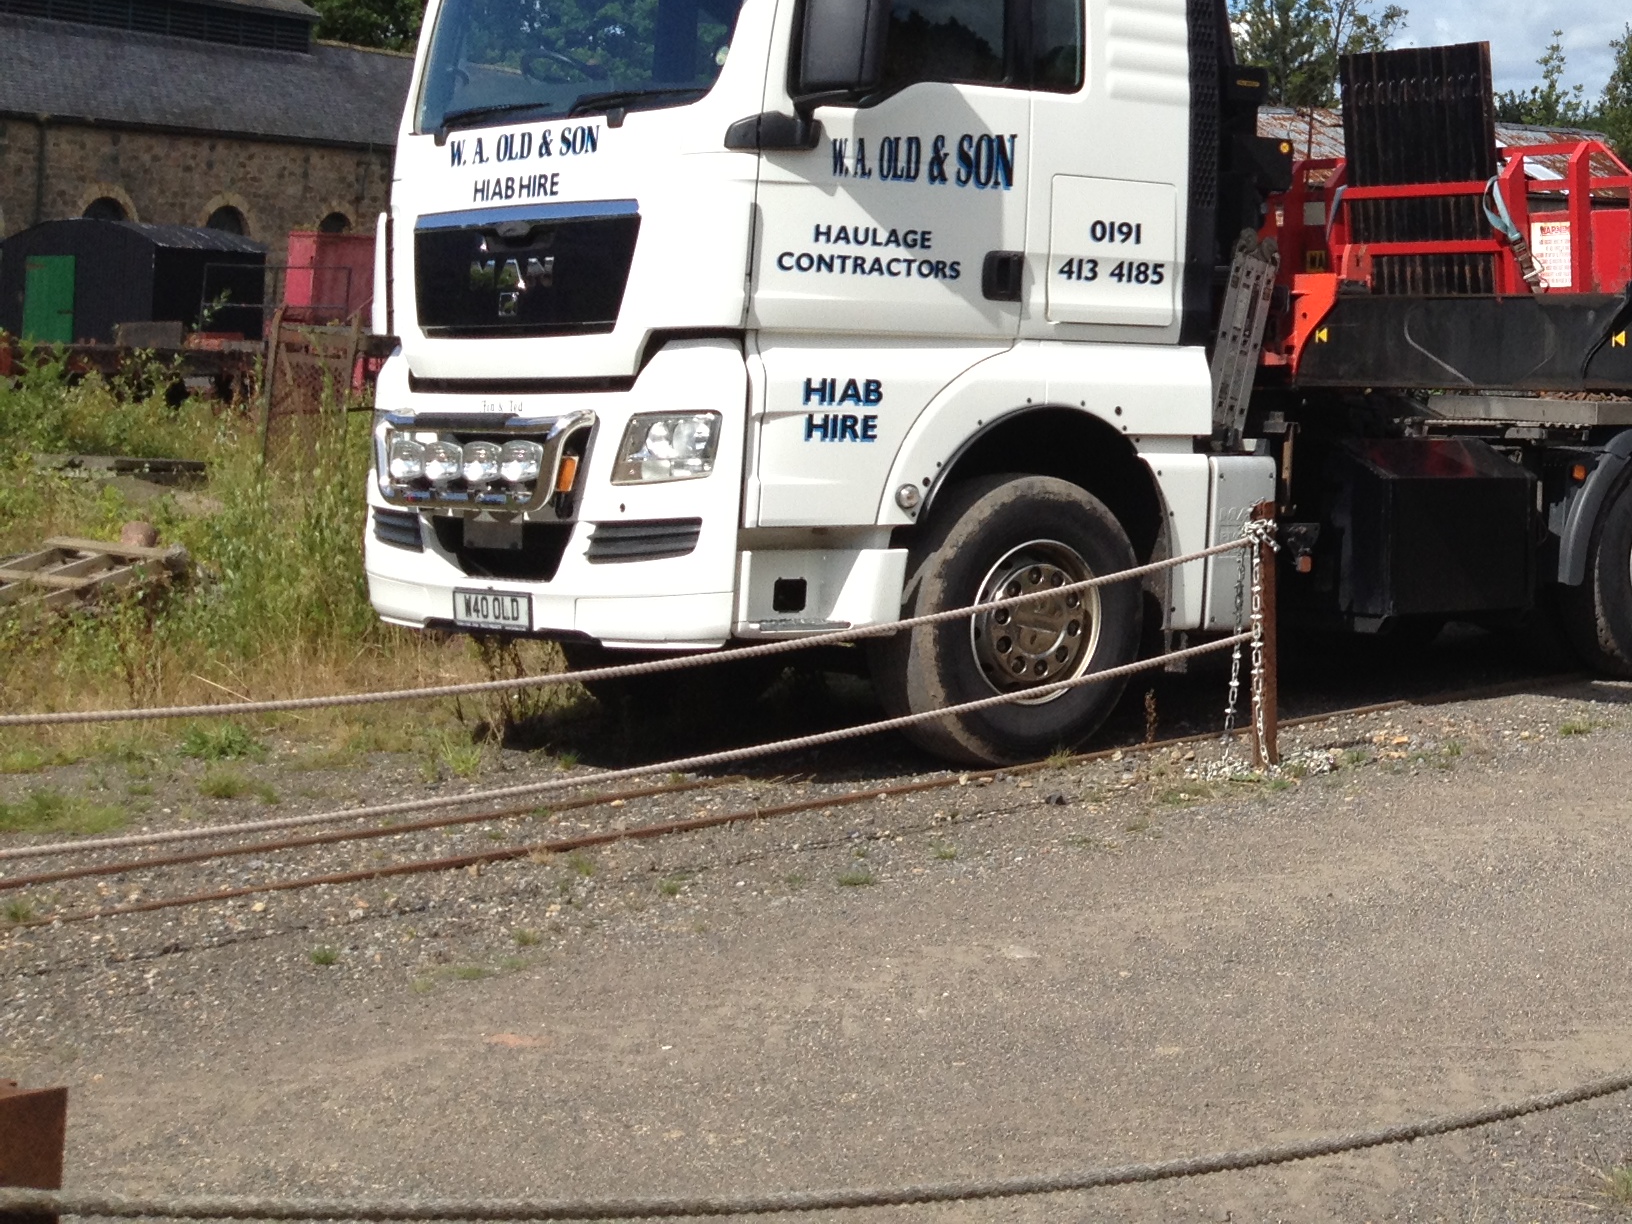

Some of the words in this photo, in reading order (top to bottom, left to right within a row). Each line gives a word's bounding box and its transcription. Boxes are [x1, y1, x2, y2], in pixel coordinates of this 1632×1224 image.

[450, 139, 467, 167] W.
[472, 137, 490, 164] A.
[496, 131, 533, 163] OLD
[538, 129, 554, 158] &
[559, 125, 600, 156] SON
[832, 137, 849, 178] W.
[853, 137, 872, 180] A.
[879, 136, 922, 182] OLD
[928, 134, 950, 185] &
[956, 133, 1018, 190] SON
[473, 176, 515, 202] HIAB
[518, 173, 560, 199] HIRE
[813, 223, 933, 250] HAULAGE
[1090, 219, 1142, 245] 0191
[470, 256, 554, 290] MAN
[777, 251, 962, 280] CONTRACTORS
[1058, 257, 1099, 282] 413
[1109, 260, 1165, 286] 4185
[803, 377, 884, 407] HIAB
[804, 413, 879, 443] HIRE
[464, 594, 489, 619] W40
[493, 596, 519, 621] OLD
